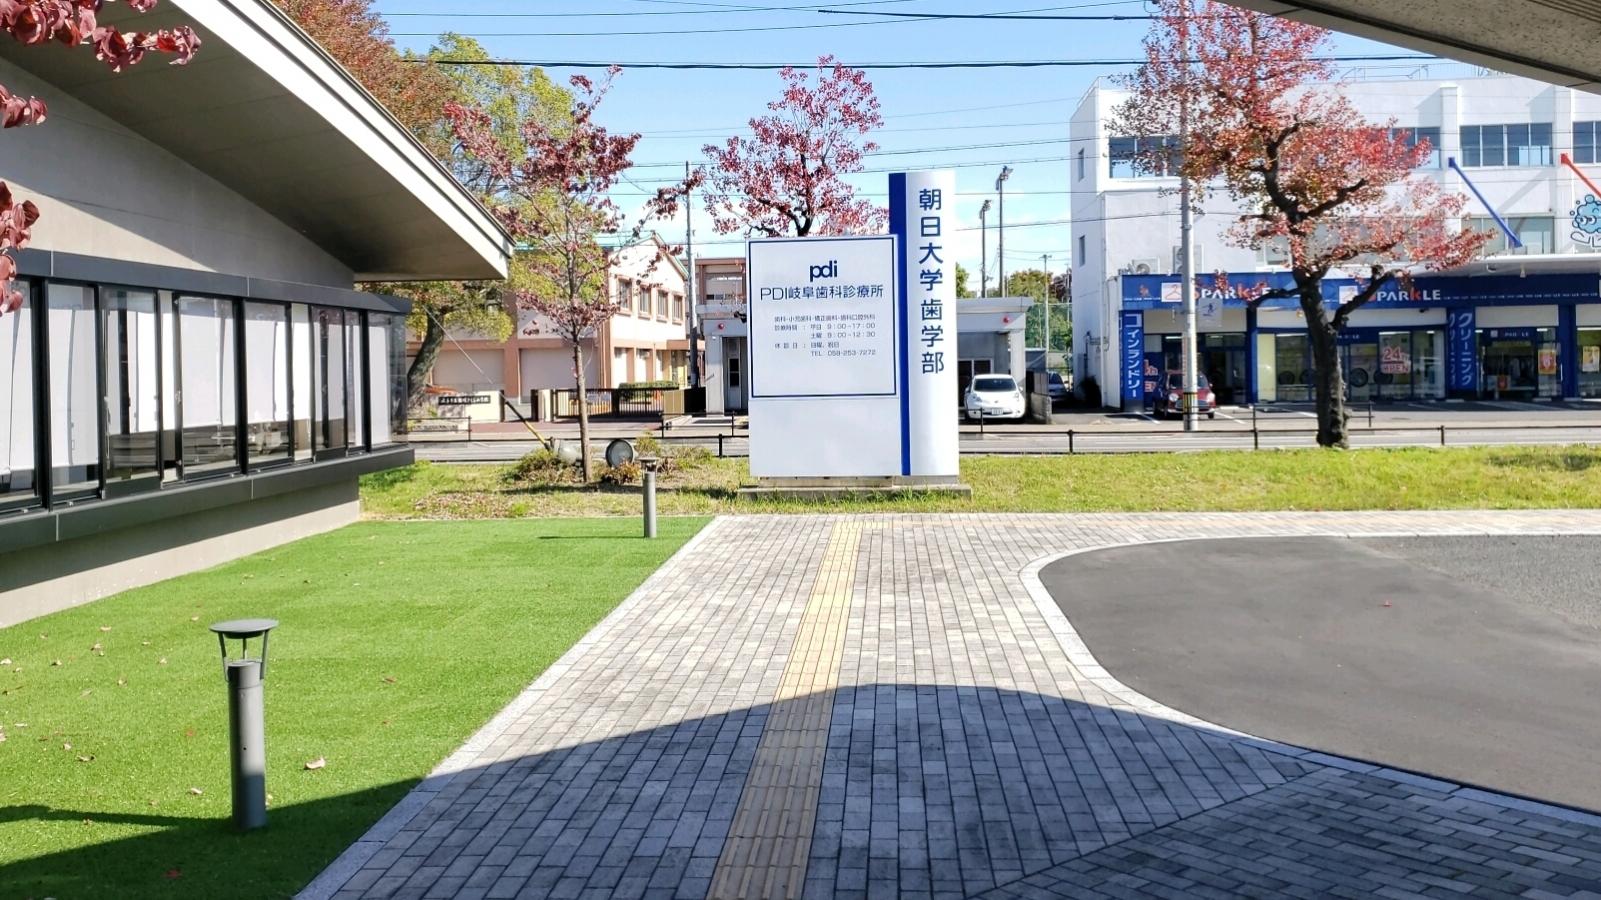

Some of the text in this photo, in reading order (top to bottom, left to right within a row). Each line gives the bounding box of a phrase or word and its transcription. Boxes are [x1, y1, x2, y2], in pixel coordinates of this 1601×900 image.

[760, 284, 884, 301] PDI岐阜歯科診療所
[809, 260, 838, 283] pdi
[918, 188, 945, 375] 朝日大学歯学部
[1125, 313, 1143, 397] コインランドリー
[1459, 313, 1474, 386] クリーニング
